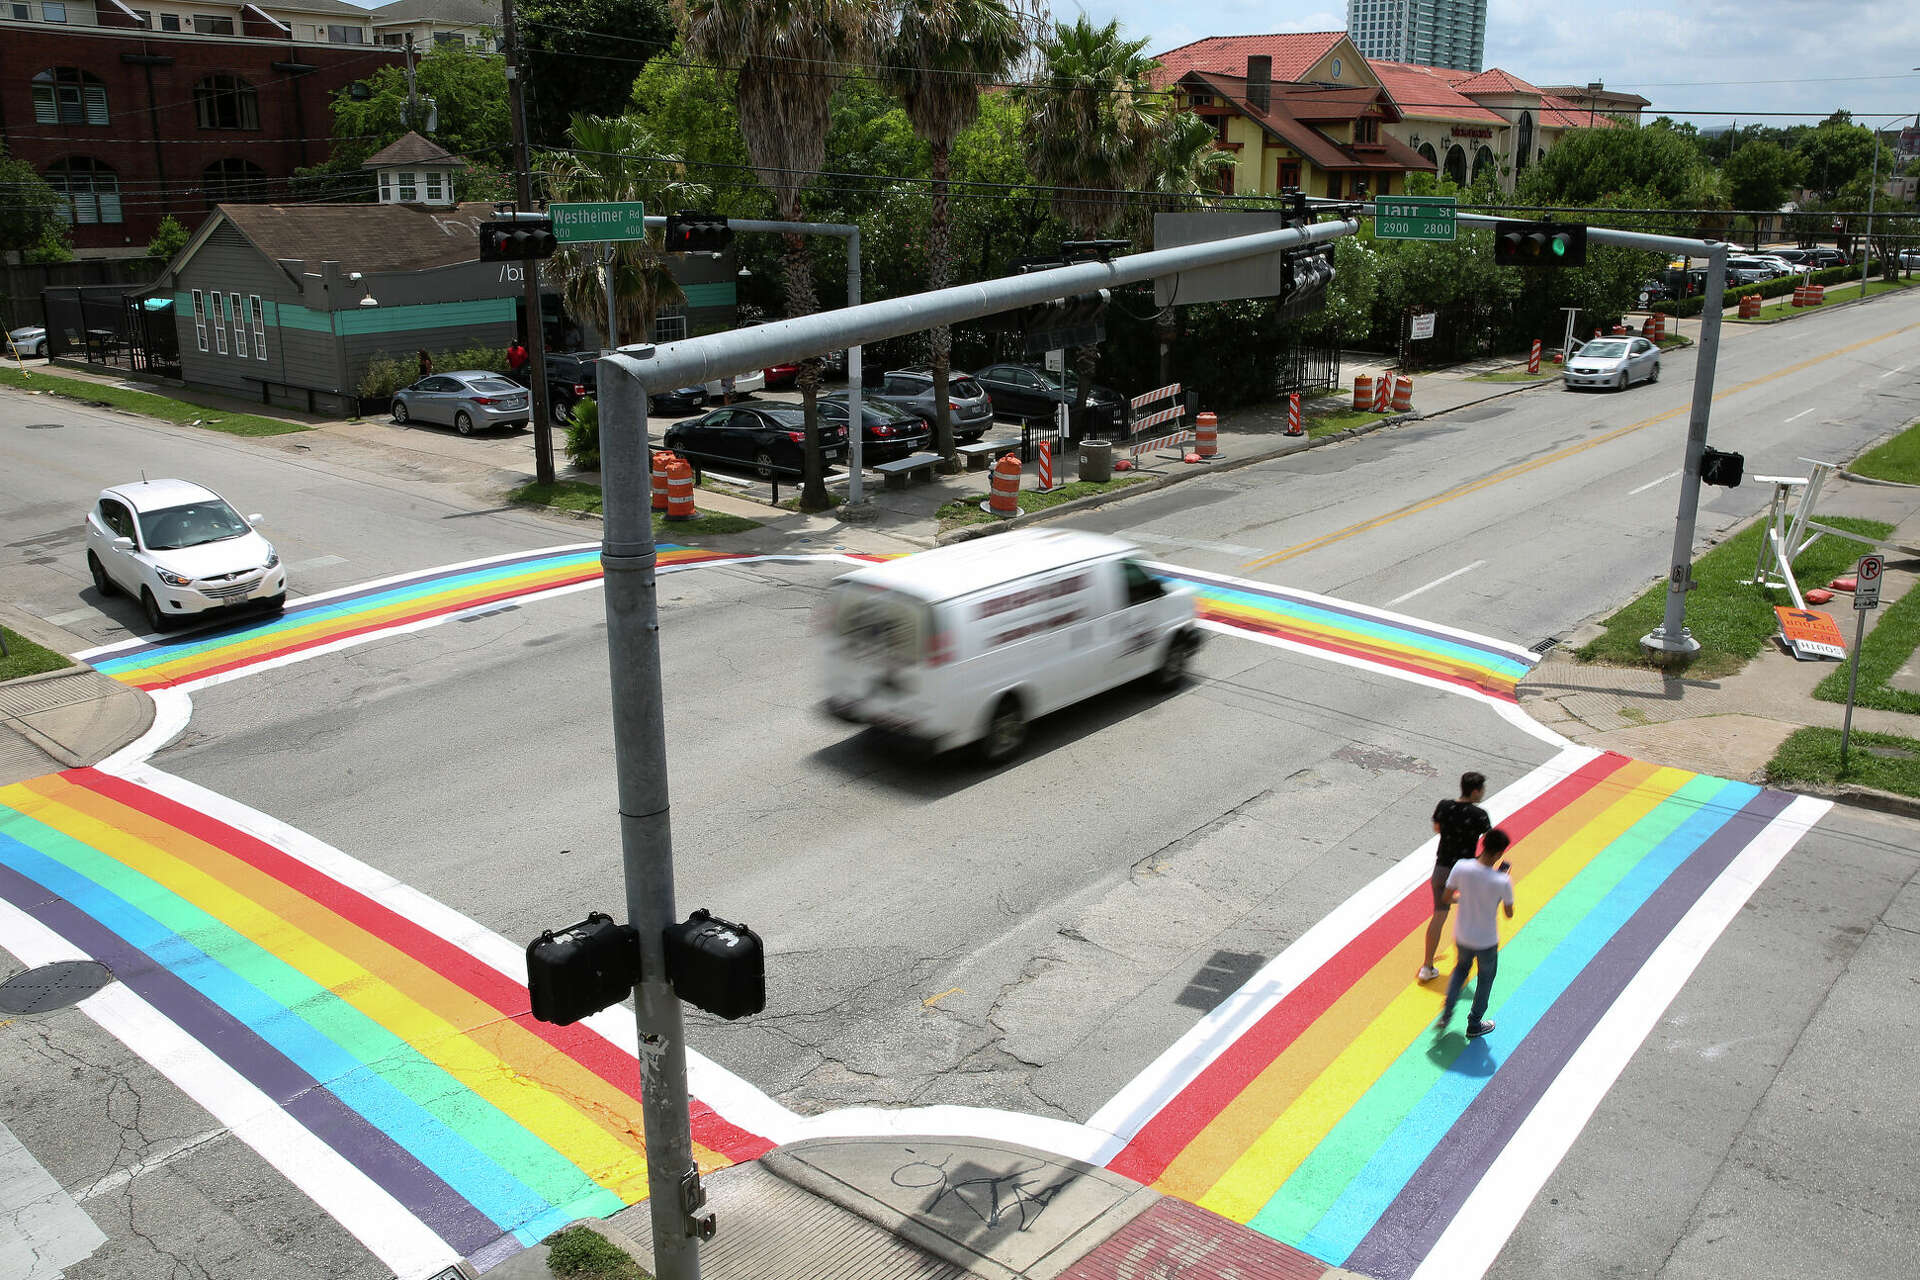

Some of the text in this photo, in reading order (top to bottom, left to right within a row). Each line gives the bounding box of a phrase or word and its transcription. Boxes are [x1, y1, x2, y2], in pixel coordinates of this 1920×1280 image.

[554, 209, 640, 225] Westheimer Rd
[1439, 207, 1451, 217] St
[554, 225, 641, 238] 300 400
[1383, 222, 1451, 234] 2900 2800
